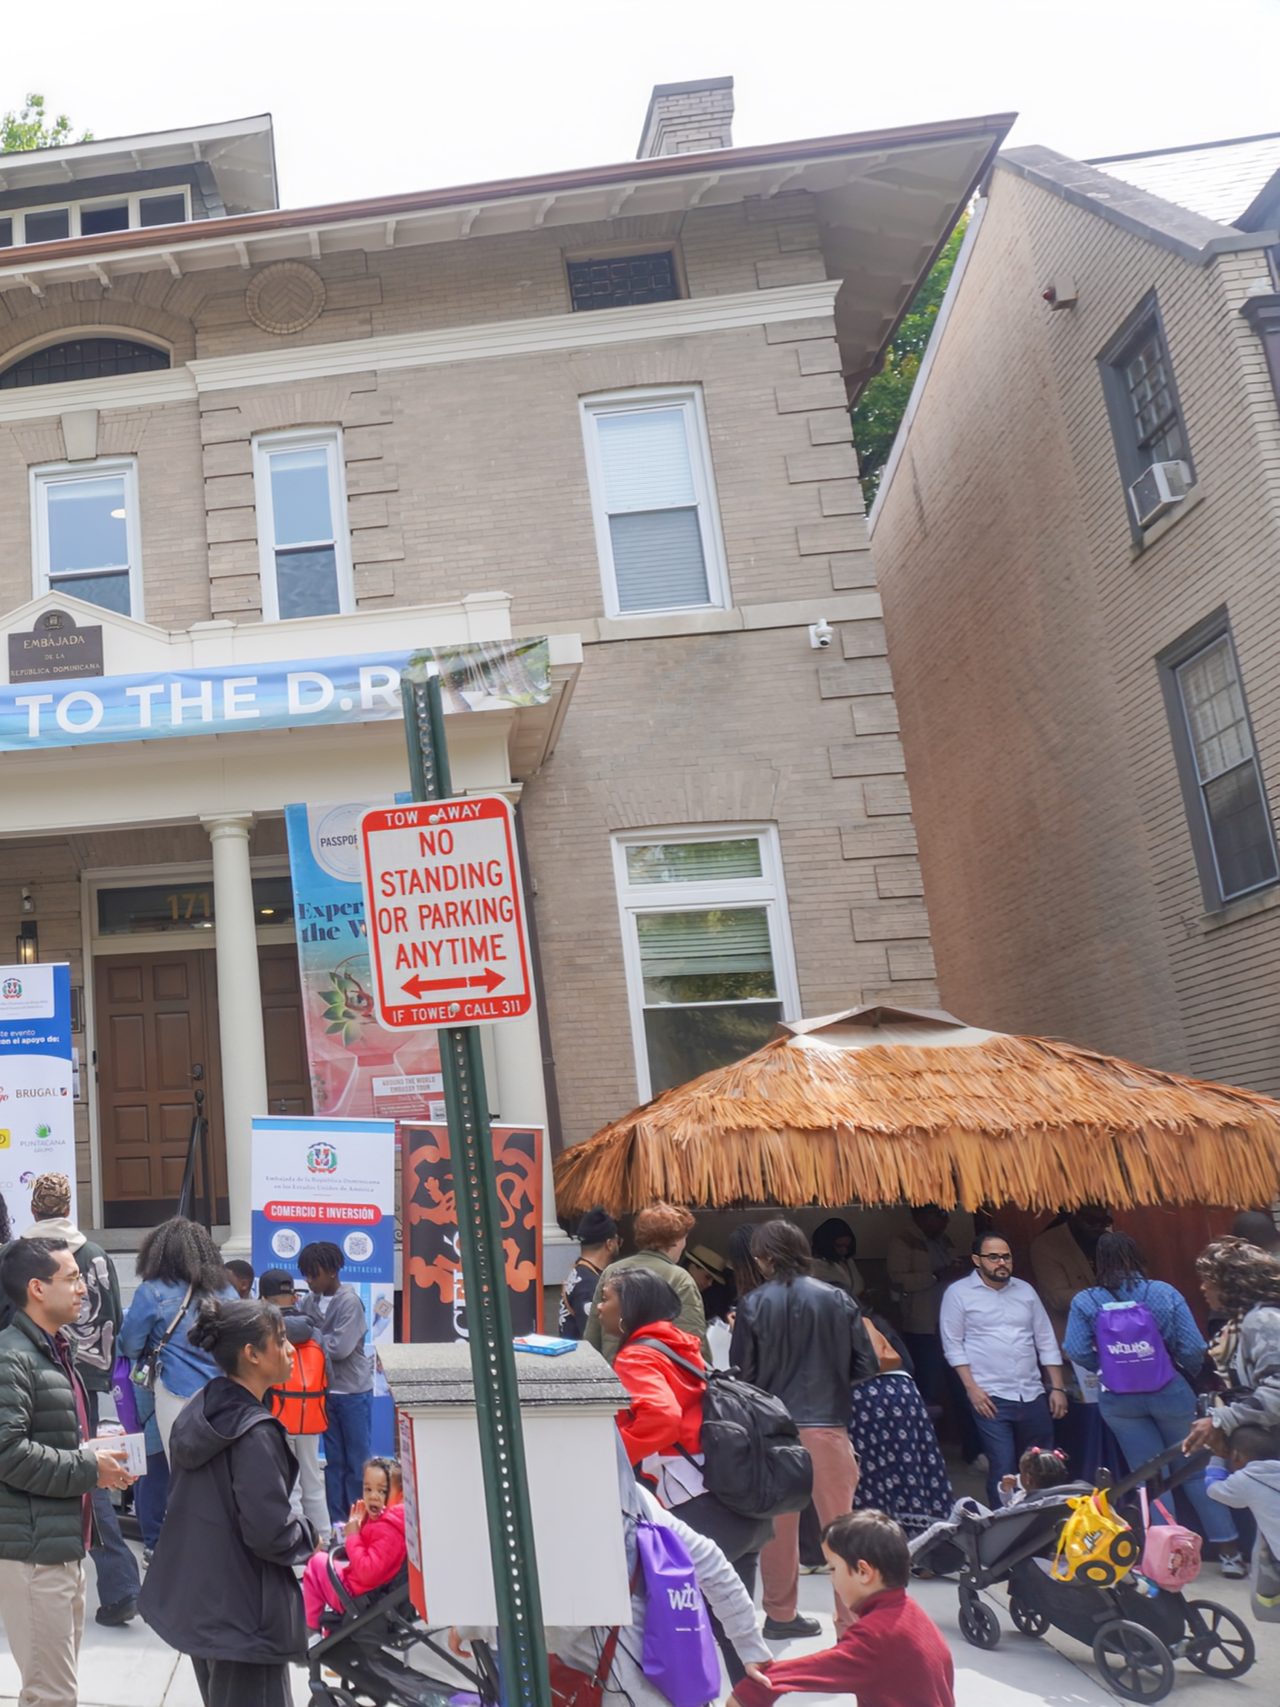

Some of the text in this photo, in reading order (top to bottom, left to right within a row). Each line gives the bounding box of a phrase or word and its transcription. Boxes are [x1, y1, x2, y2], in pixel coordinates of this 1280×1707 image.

[23, 635, 85, 649] EMBAJADA
[52, 663, 101, 673] DOMINICANA
[15, 691, 104, 737] TO
[126, 676, 261, 728] THE
[287, 661, 439, 715] D.R
[384, 803, 482, 826] TOW AWAY
[419, 829, 454, 857] NO
[380, 859, 503, 898] STANDING
[378, 907, 408, 935] OR
[419, 896, 513, 931] PARKING
[302, 922, 341, 943] the
[395, 934, 507, 970] ANYTIME
[392, 999, 521, 1023] IF TOWED CALL 311
[10, 1029, 36, 1037] evento
[12, 1037, 20, 1045] el
[21, 1037, 45, 1046] apoyo
[47, 1035, 60, 1043] de:
[16, 1087, 59, 1098] BRUGAL
[271, 1205, 375, 1220] COMERCIO E INVERSIÓN
